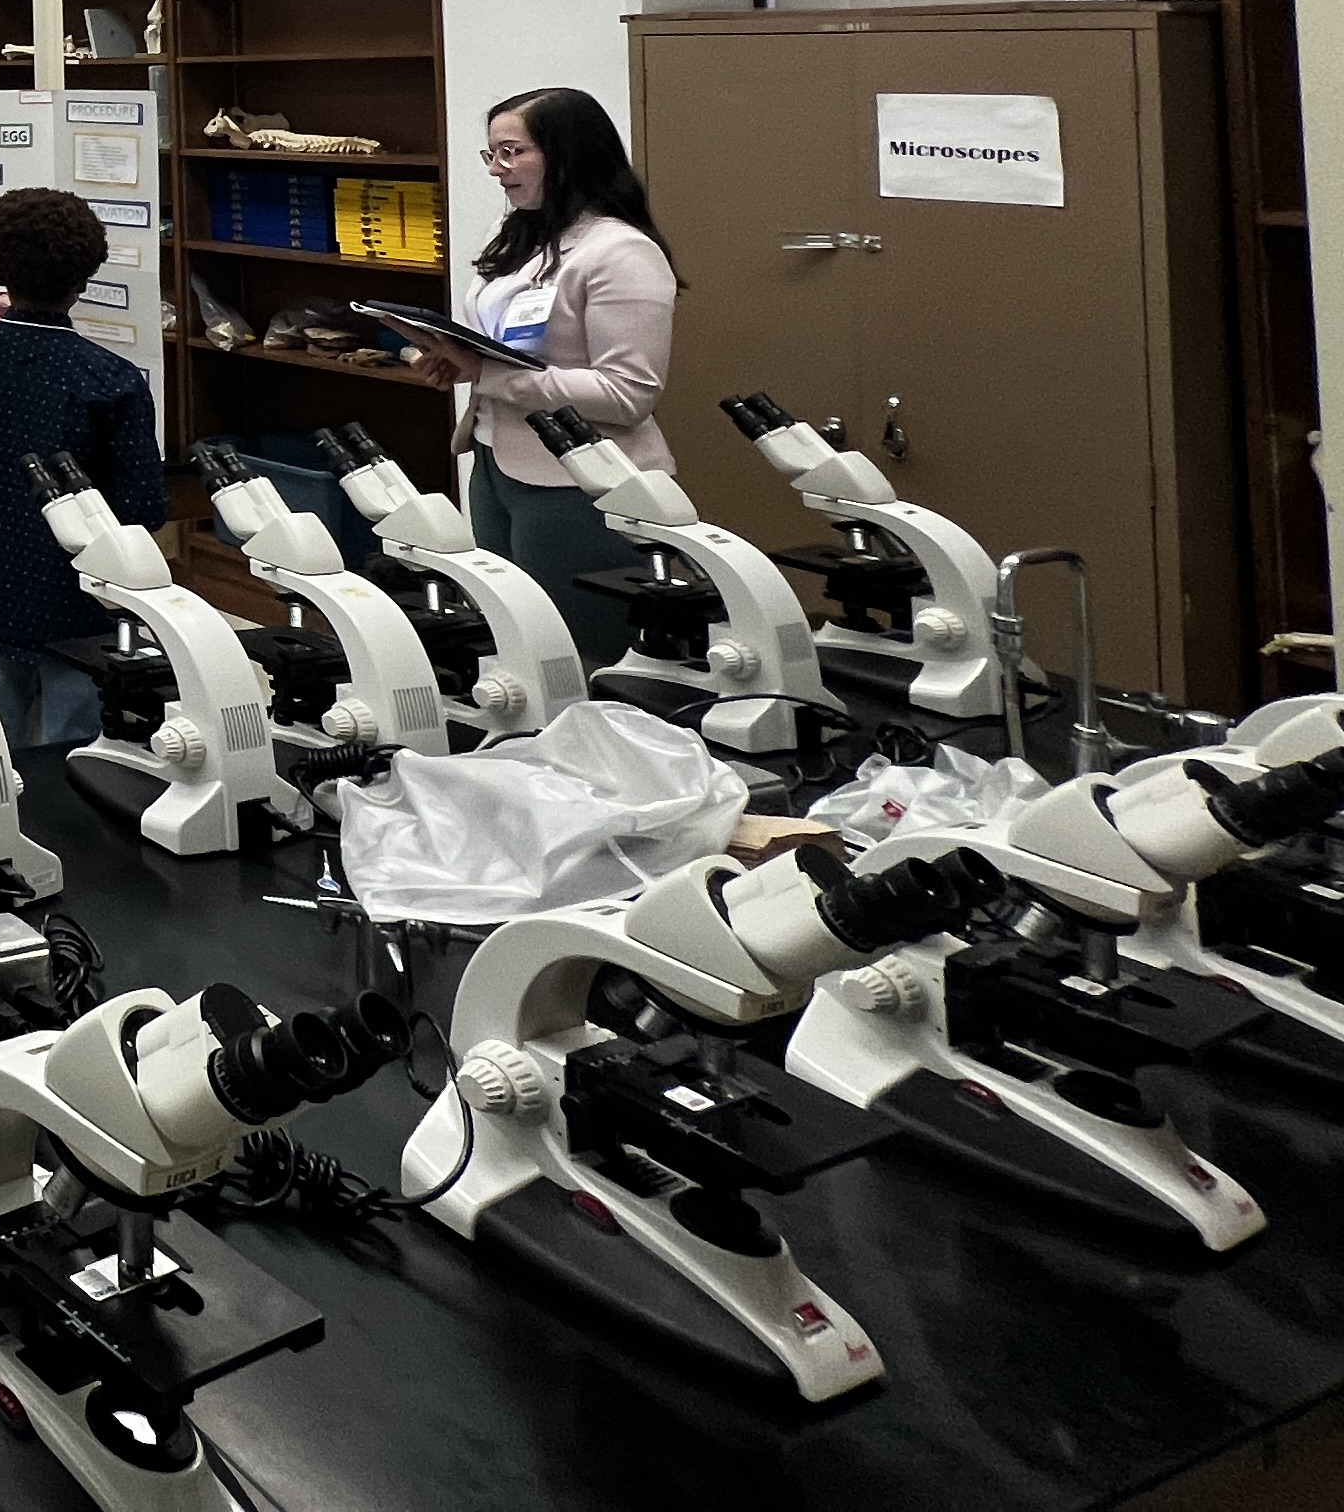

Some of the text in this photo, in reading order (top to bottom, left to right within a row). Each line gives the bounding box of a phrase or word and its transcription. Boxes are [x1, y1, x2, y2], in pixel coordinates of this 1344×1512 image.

[71, 104, 136, 118] PROCEDURE
[2, 129, 28, 143] EGG
[889, 140, 1040, 164] Microscopes
